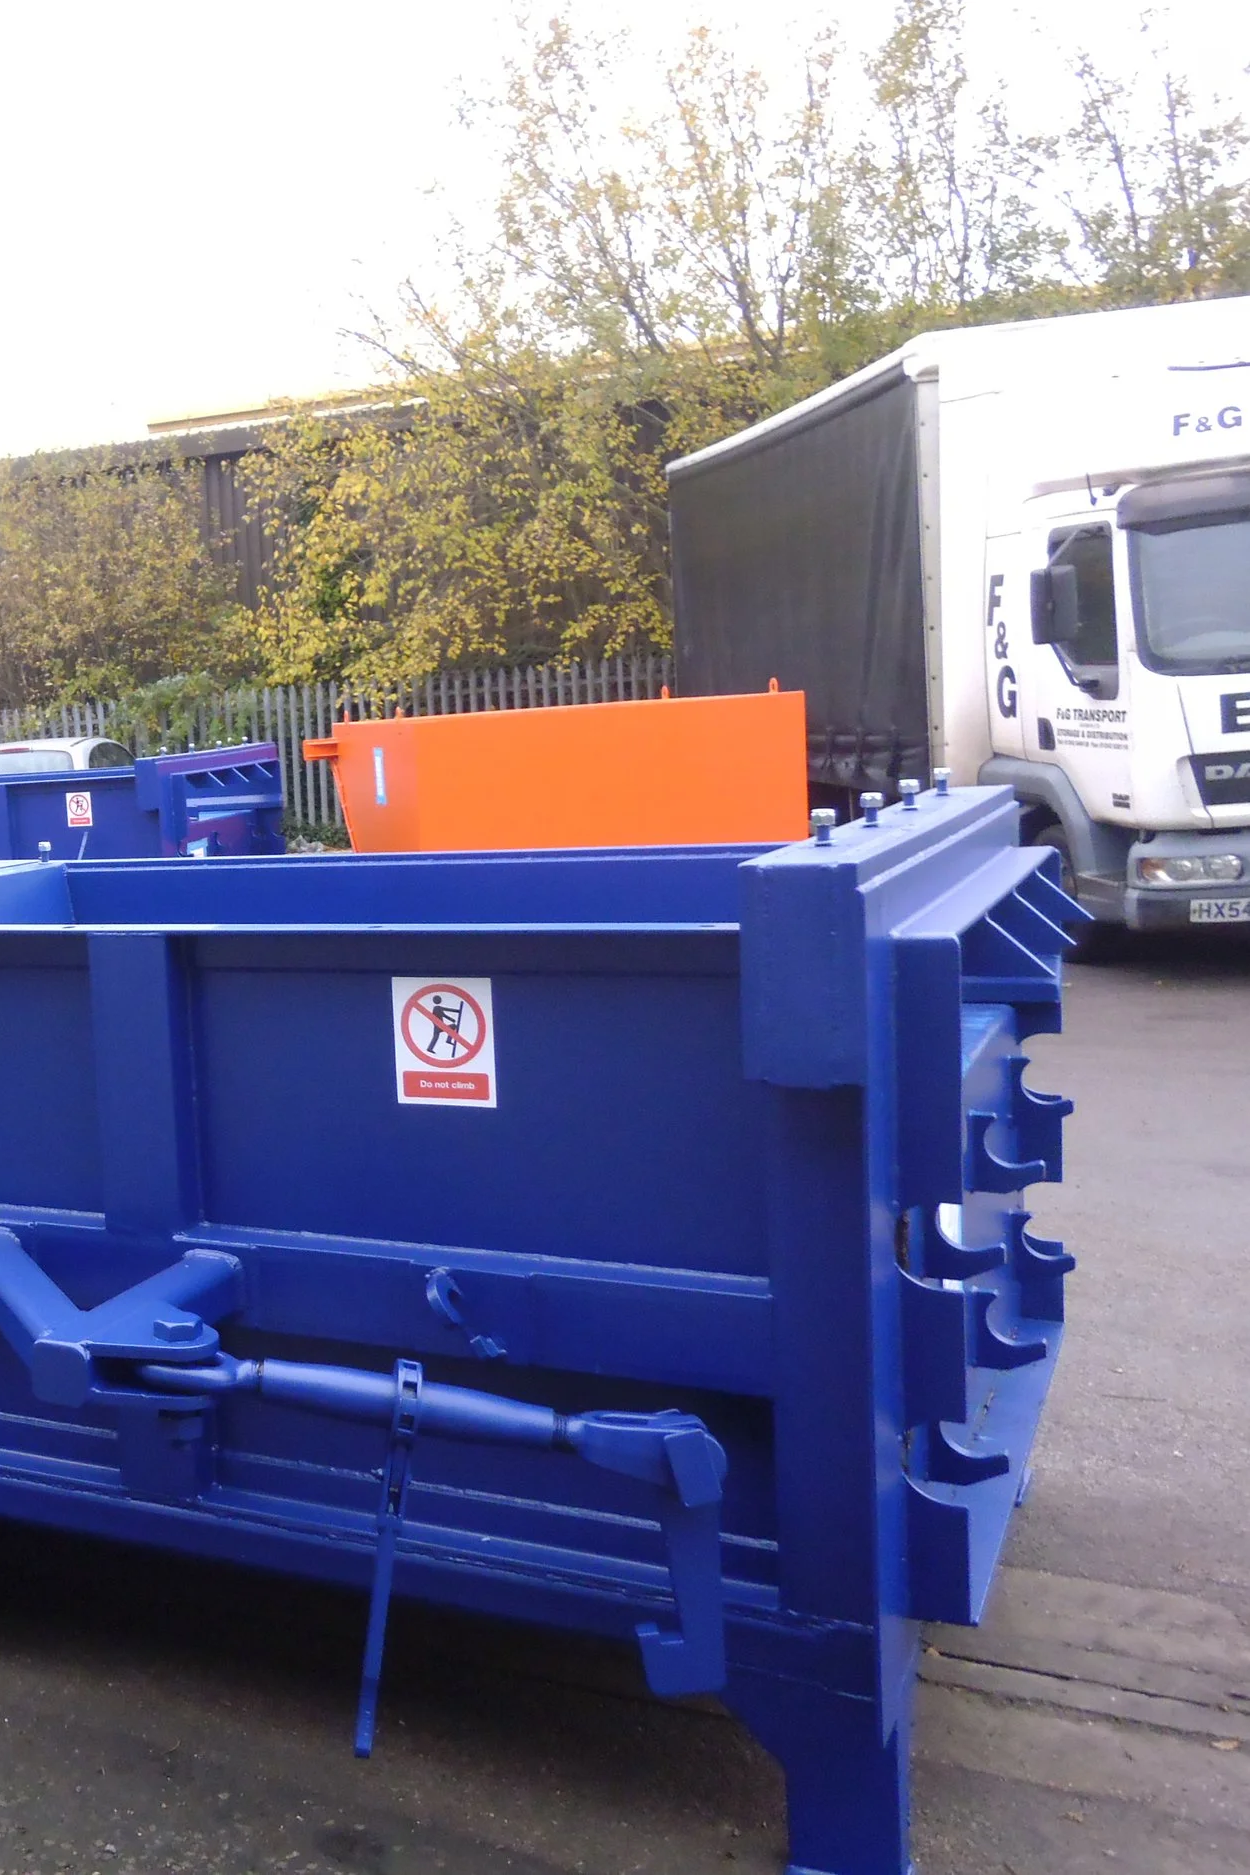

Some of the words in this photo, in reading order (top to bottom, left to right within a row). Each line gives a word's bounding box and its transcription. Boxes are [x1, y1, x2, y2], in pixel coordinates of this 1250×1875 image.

[1073, 708, 1127, 723] TRANSPORT
[1087, 730, 1128, 741] DISTRIBUTION
[420, 1080, 433, 1089] Do
[434, 1081, 450, 1089] not
[451, 1081, 475, 1090] climb
